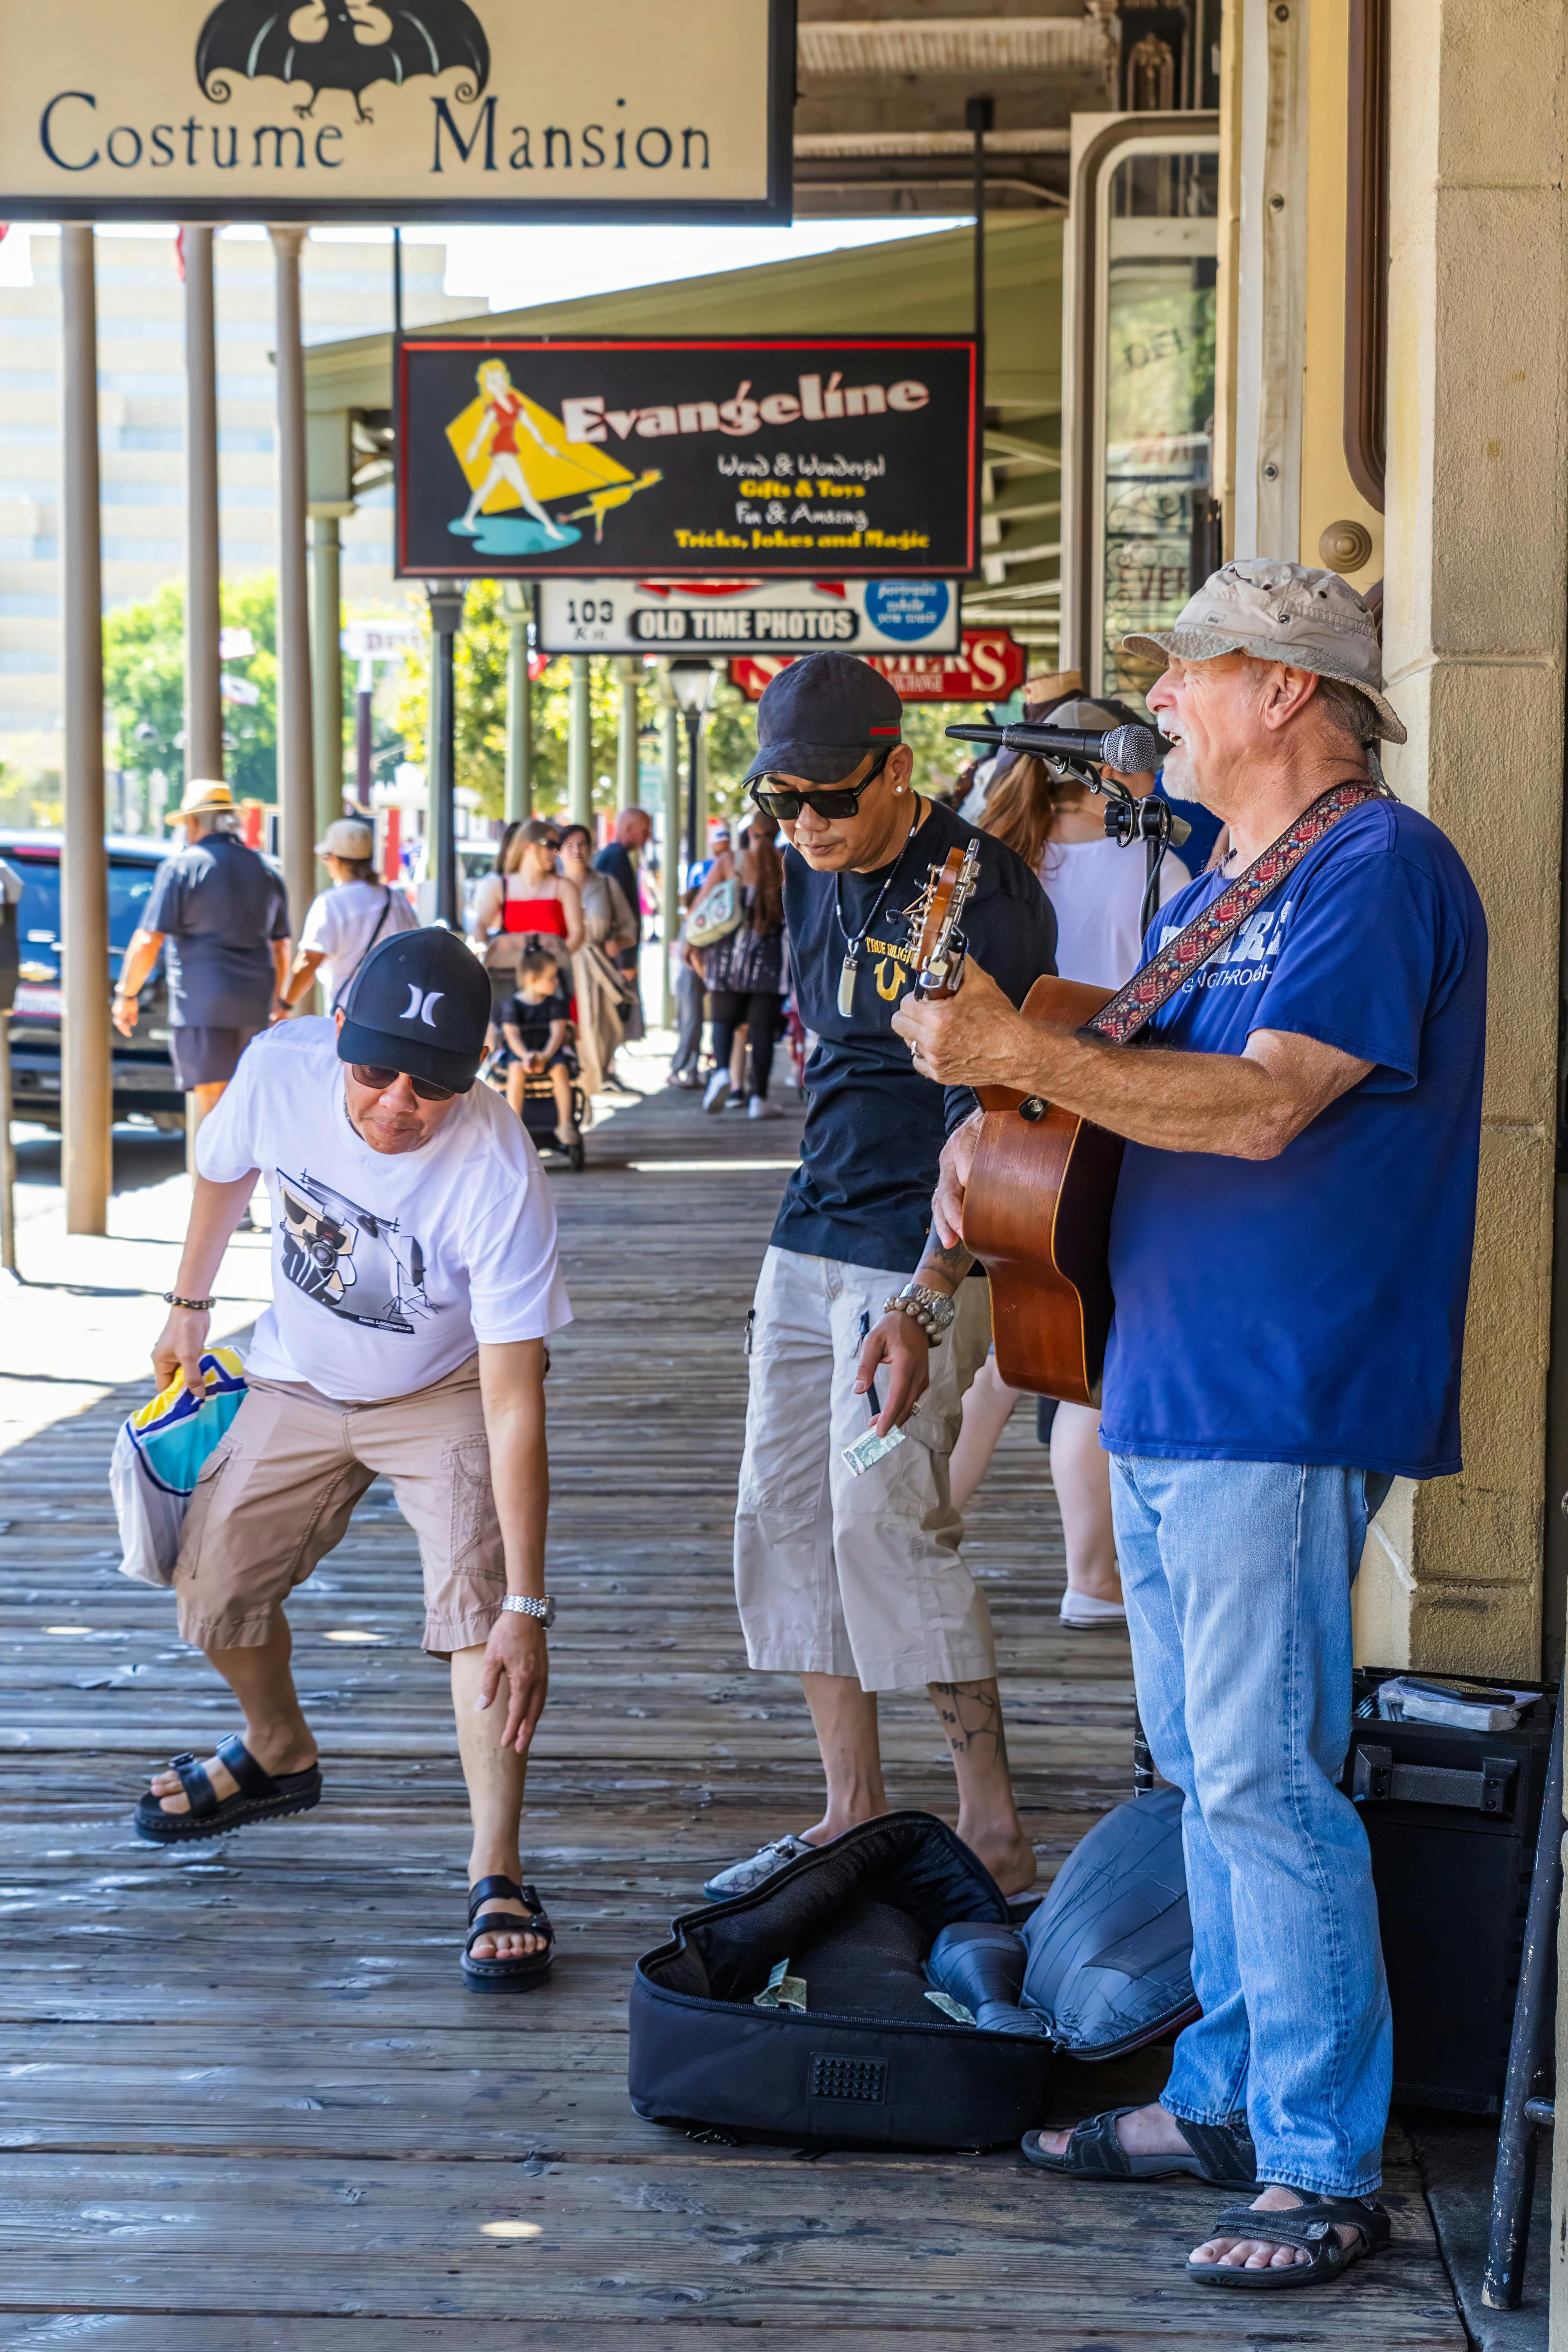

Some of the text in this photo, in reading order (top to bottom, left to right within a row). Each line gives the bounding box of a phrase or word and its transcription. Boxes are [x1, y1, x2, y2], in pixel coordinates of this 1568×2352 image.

[40, 91, 710, 172] Costume Mansion
[561, 371, 930, 445] Evangeline
[717, 452, 886, 481] Weird & Wonderful
[739, 479, 866, 500] Gifts & Toys
[735, 500, 869, 532] Fun & Amazing
[674, 529, 930, 550] Tricks, Jokes and Magic
[568, 600, 614, 623] 103
[574, 628, 588, 641] K
[638, 610, 855, 640] OLD TIME PHOTOS
[865, 936, 886, 955] TRUE
